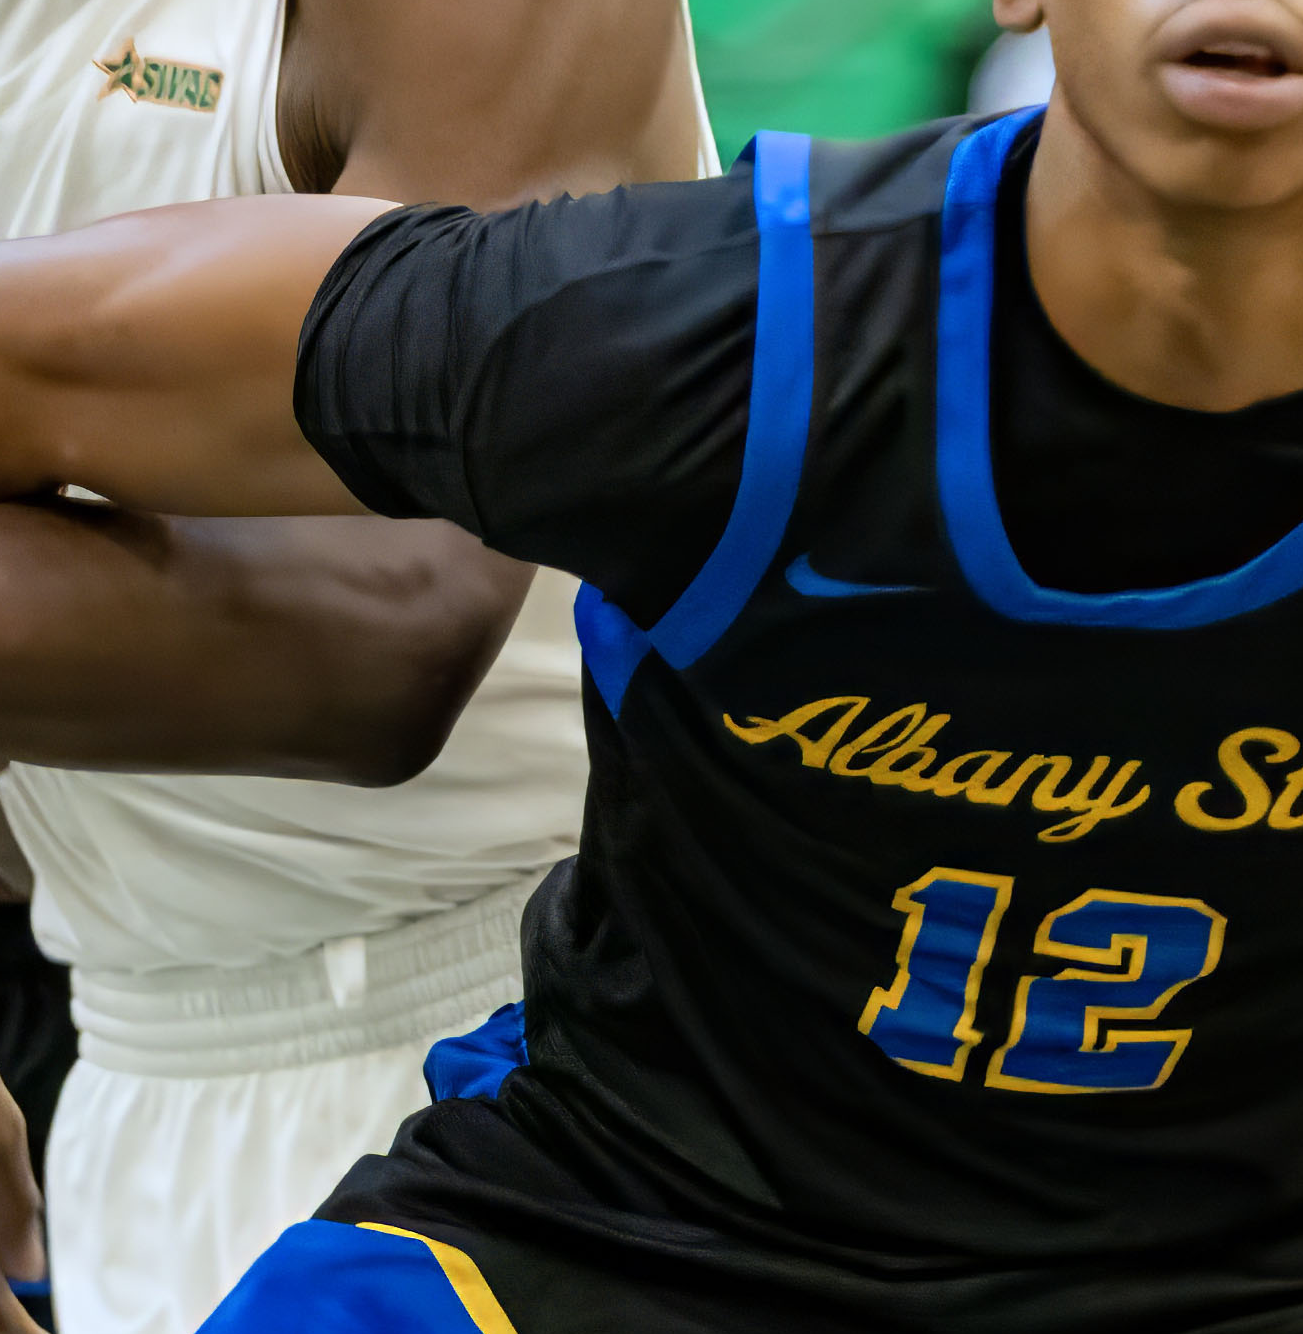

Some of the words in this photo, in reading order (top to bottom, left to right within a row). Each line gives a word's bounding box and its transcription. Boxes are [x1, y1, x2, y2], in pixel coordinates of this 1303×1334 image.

[136, 60, 221, 108] SWAC
[723, 696, 1150, 842] Albany
[858, 867, 1227, 1094] 12
